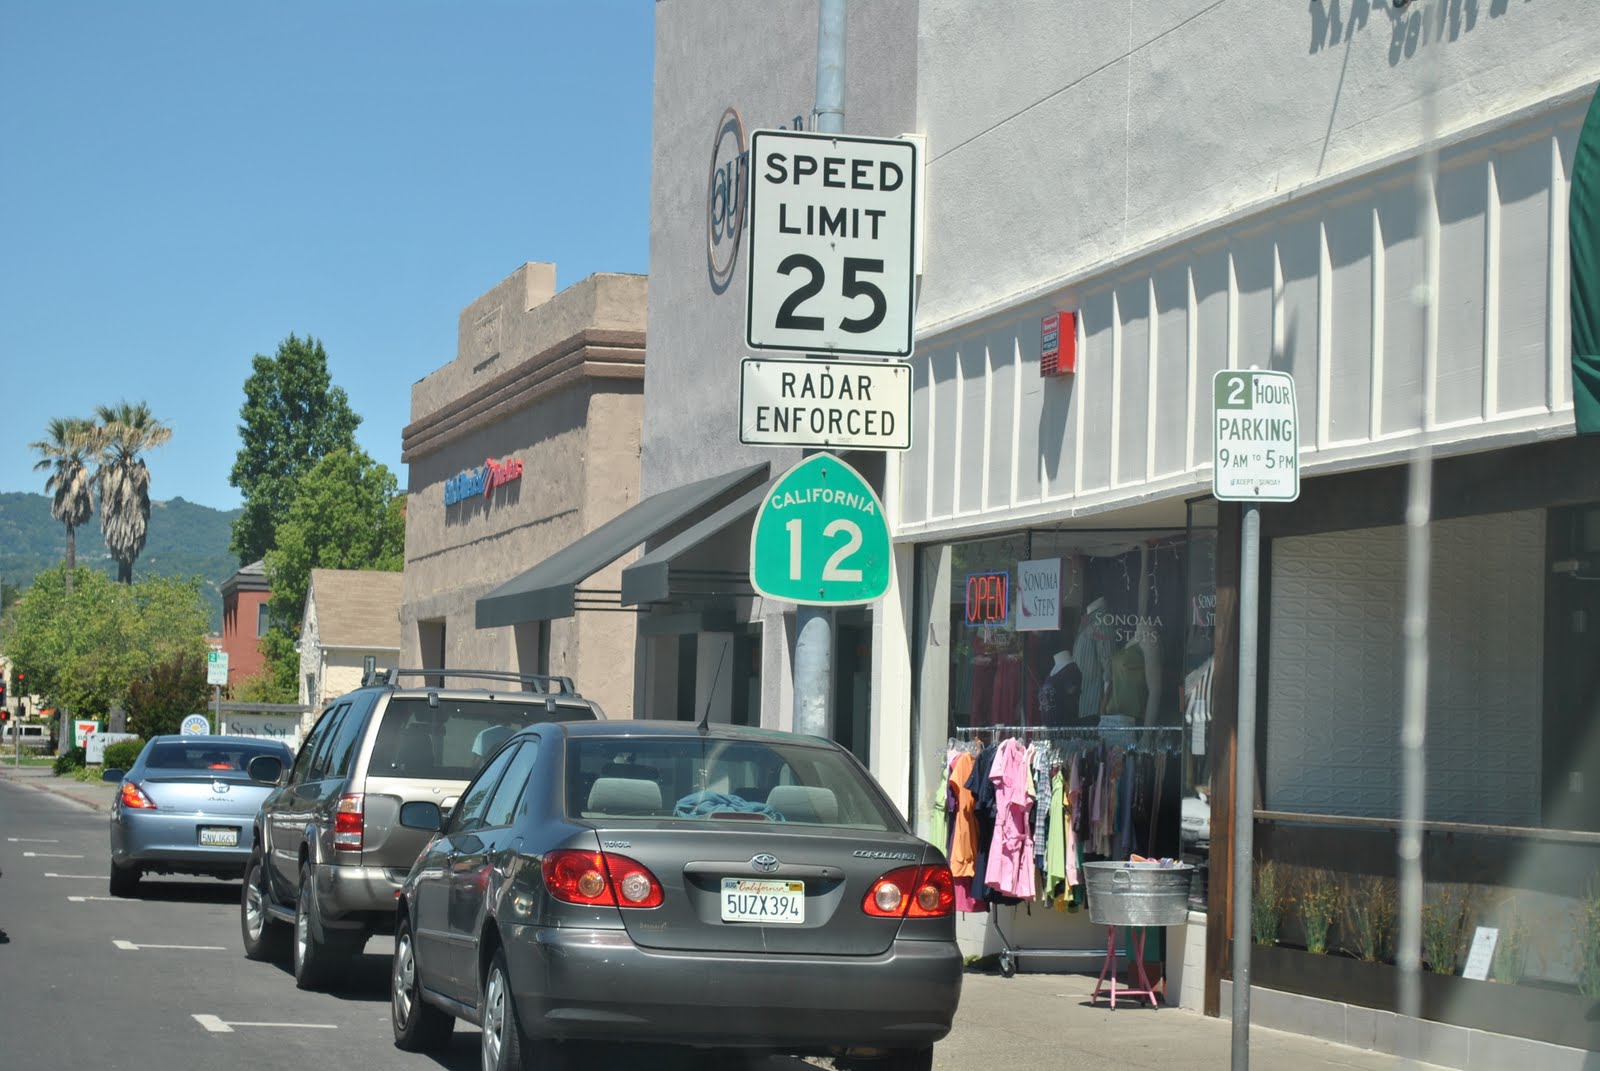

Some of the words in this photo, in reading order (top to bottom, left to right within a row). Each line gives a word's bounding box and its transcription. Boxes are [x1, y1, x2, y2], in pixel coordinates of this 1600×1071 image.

[764, 152, 904, 192] SPEED
[779, 203, 887, 240] LIMIT
[775, 253, 888, 334] 25
[781, 372, 873, 401] RADAR
[1227, 377, 1245, 405] 2
[1255, 384, 1291, 405] HOUR
[756, 406, 895, 437] ENFORCED
[1219, 418, 1292, 441] PARKING
[771, 488, 875, 516] CALIFORNIA
[785, 518, 863, 582] 12
[1023, 570, 1058, 591] SONOMA
[967, 576, 1006, 622] OPEN
[1033, 596, 1055, 617] STEPS
[1198, 593, 1217, 608] SONO
[1094, 611, 1163, 626] SONOMA
[1115, 628, 1158, 643] STEPS
[604, 840, 631, 849] TOYOTA
[853, 850, 901, 861] COROLLA
[739, 880, 785, 894] California
[727, 894, 799, 916] 5UZX394
